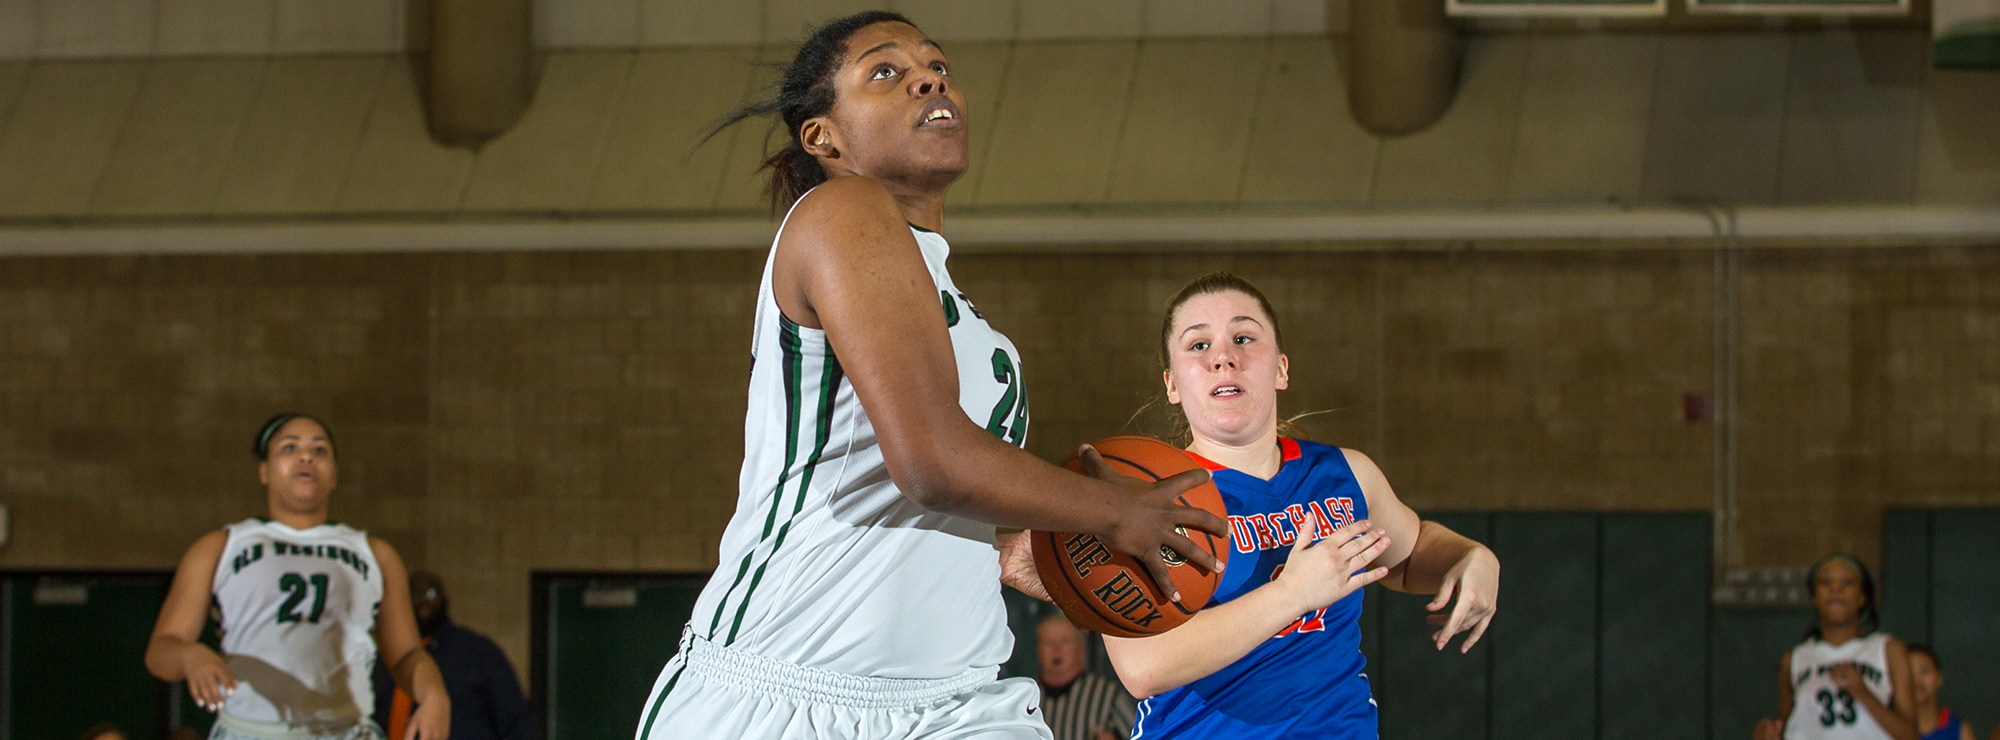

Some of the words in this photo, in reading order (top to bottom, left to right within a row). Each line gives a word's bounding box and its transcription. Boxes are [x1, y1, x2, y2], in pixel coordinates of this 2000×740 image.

[986, 348, 1028, 446] 24
[1227, 497, 1358, 554] URCHASE
[233, 544, 263, 573] OLD
[274, 542, 369, 580] WESTBURY
[1061, 532, 1114, 580] HE
[277, 572, 330, 624] 21
[1092, 568, 1164, 628] ROCK
[1816, 687, 1857, 727] 33
